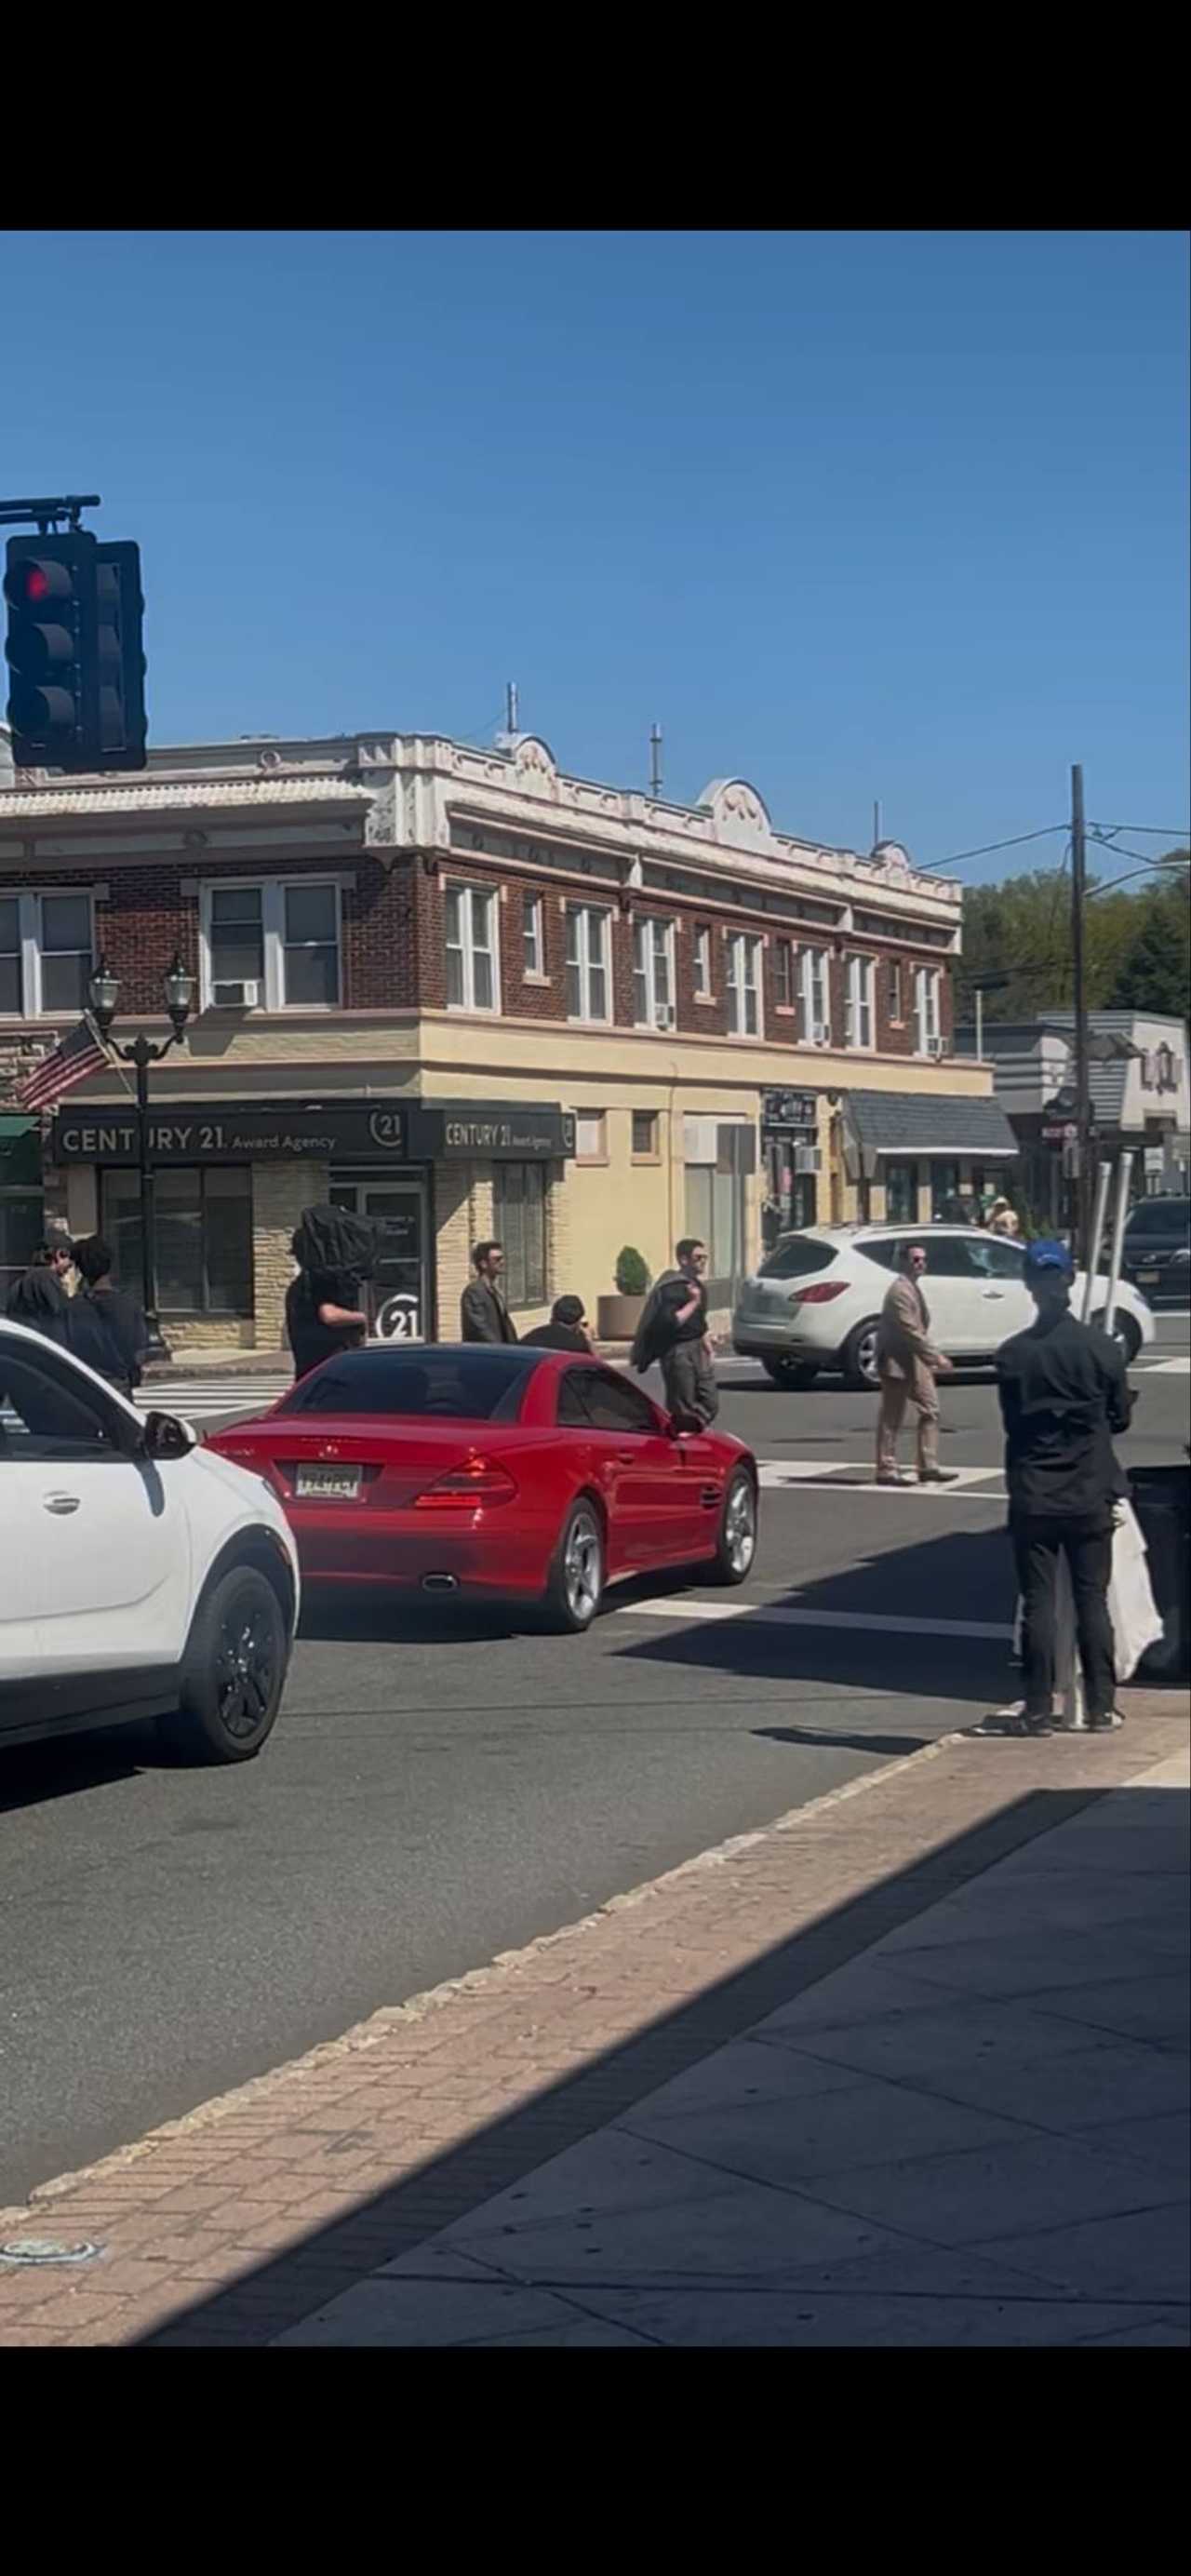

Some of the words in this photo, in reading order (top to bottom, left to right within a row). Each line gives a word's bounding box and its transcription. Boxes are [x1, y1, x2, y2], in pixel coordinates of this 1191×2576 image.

[380, 1114, 400, 1135] 21
[447, 1122, 499, 1147] CENTURY
[232, 1135, 278, 1148] Award
[282, 1134, 337, 1151] Agency
[390, 1309, 418, 1338] 21
